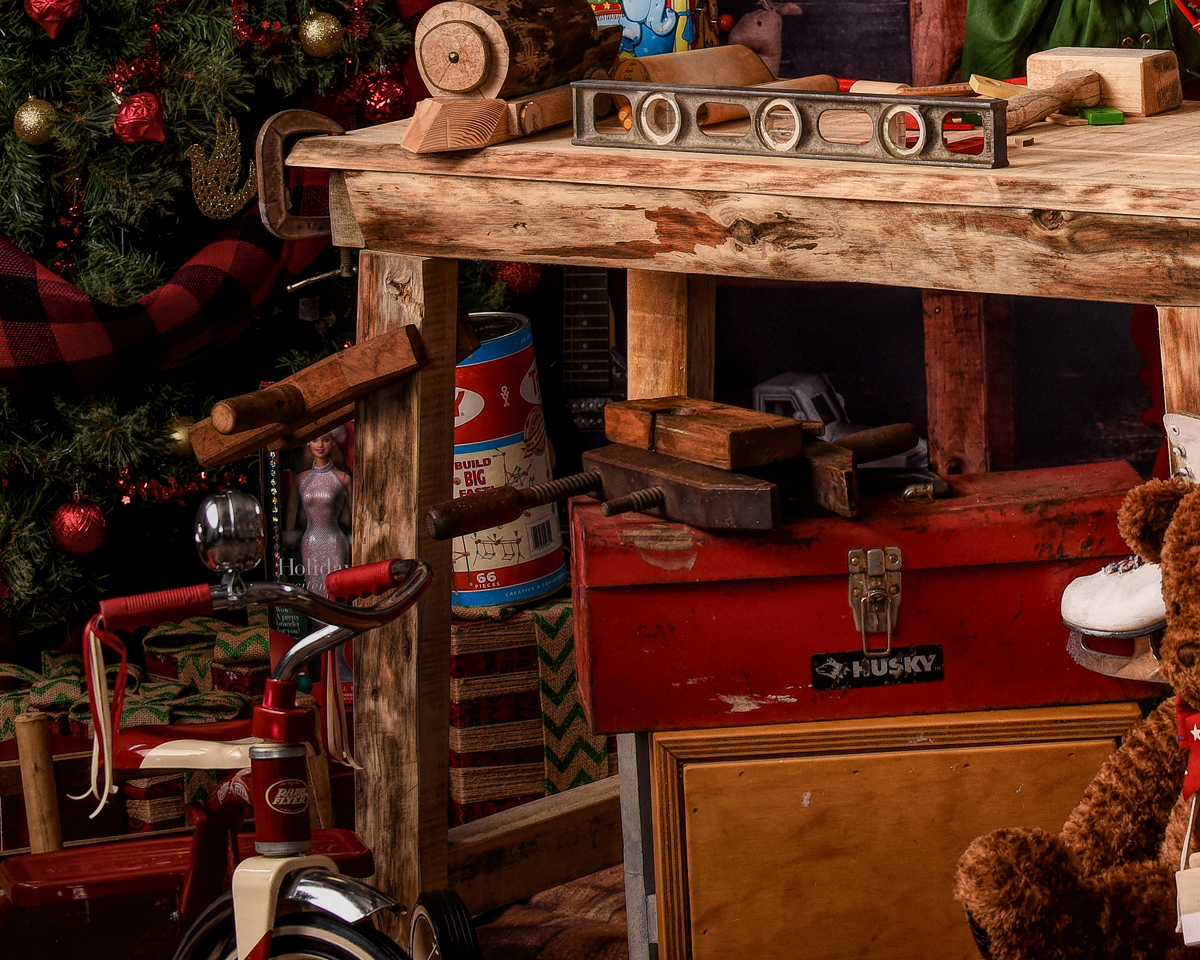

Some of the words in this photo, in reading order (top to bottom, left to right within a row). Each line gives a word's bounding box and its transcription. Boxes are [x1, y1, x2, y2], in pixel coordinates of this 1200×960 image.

[454, 457, 492, 470] BUILD
[464, 469, 486, 487] BIG
[476, 571, 497, 584] 66
[474, 581, 500, 589] PIECES
[852, 654, 937, 678] HUSKY
[272, 795, 308, 805] FLYER
